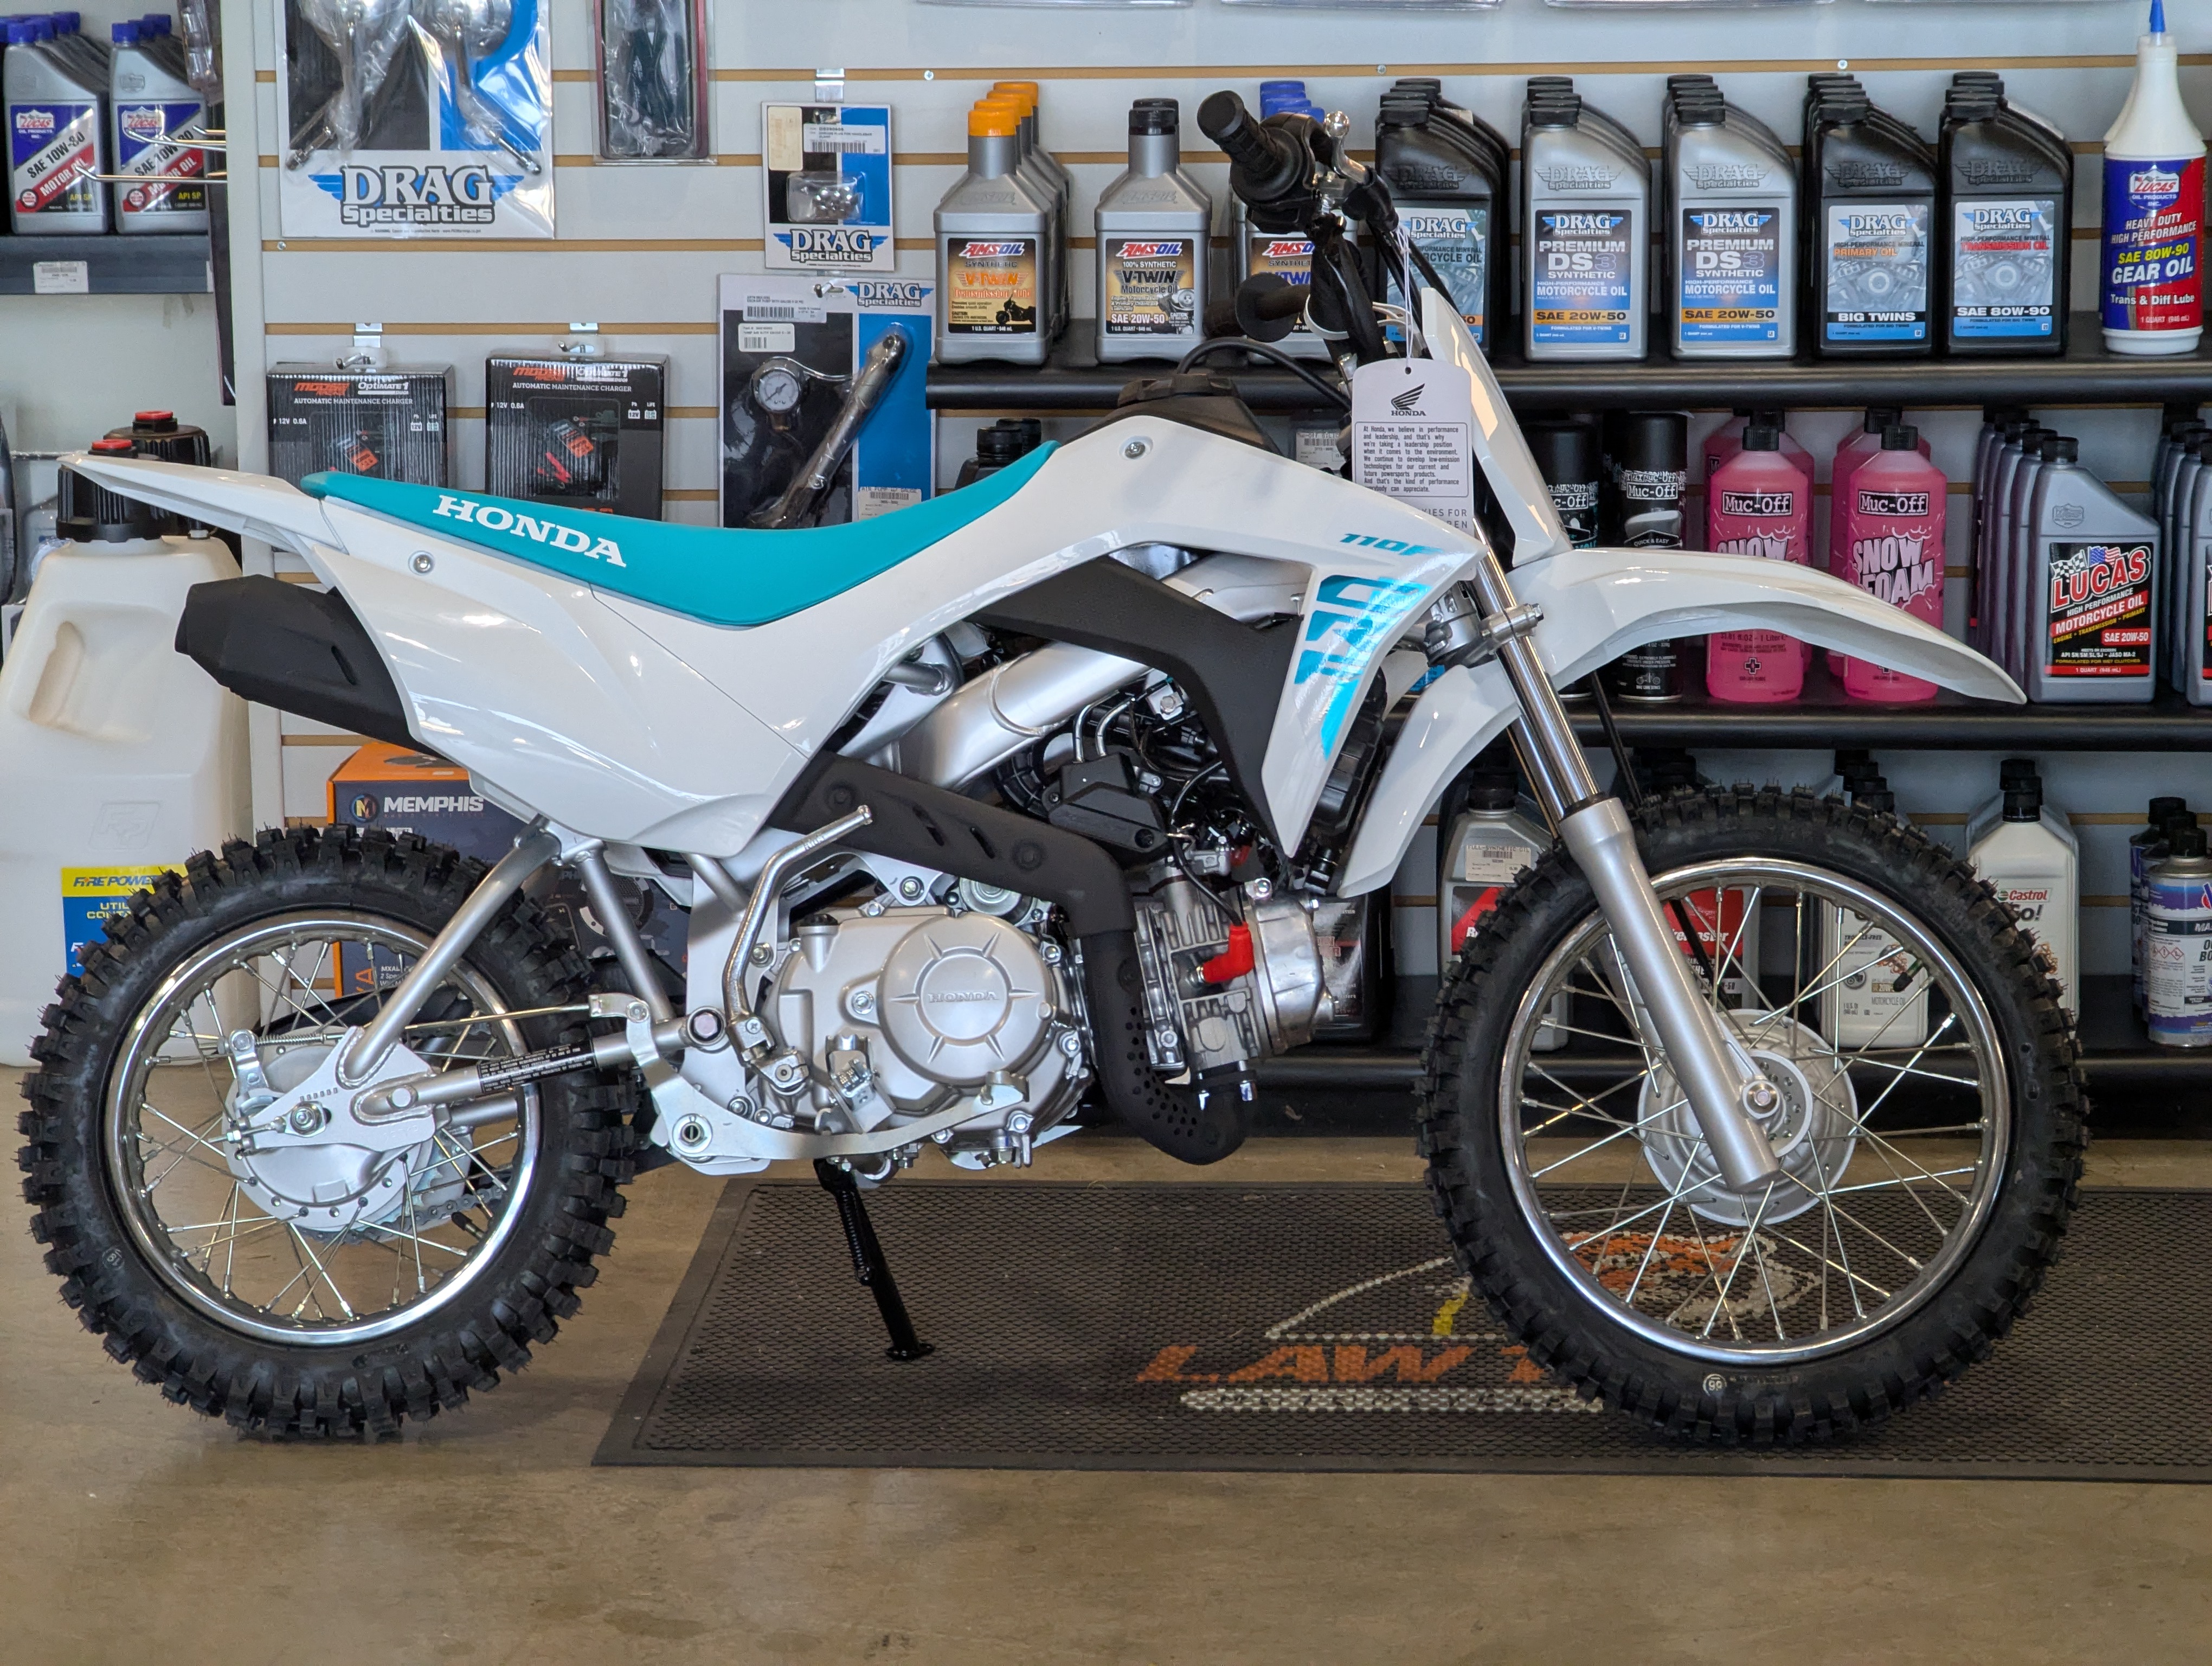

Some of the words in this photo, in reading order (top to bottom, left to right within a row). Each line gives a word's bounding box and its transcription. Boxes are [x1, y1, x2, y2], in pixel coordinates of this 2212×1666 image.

[27, 159, 48, 178] SAE
[134, 158, 155, 176] SAE
[179, 157, 197, 172] OIL
[40, 169, 73, 196] MOTOR
[340, 165, 494, 205] DRAG
[2134, 182, 2176, 193] LUCAS
[342, 205, 494, 226] Specialties
[1554, 213, 1611, 230] DRAG
[1702, 212, 1759, 228] DRAG
[1849, 215, 1907, 231] DRAG
[1974, 208, 2031, 225] DRAG
[2125, 217, 2155, 230] HEAVY
[2158, 212, 2182, 226] DUTY
[1410, 217, 1466, 233] DRAG
[1702, 226, 1760, 234] Specialties
[2111, 233, 2129, 244] HIGH
[2132, 220, 2196, 242] PERFORMANCE
[790, 229, 872, 252] DRAG
[1410, 231, 1466, 239] Specialties
[959, 242, 1025, 259] AMSOIL
[1116, 242, 1182, 259] AMSOIL
[1262, 241, 1315, 258] AMSO
[1539, 241, 1625, 252] PREMIUM
[1687, 239, 1773, 251] PREMIUM
[1834, 248, 1877, 257] PRIMARY
[1881, 248, 1898, 257] OIL
[2034, 241, 2049, 250] OIL
[790, 251, 872, 262] Specialties
[1465, 253, 1482, 263] OIL
[1696, 251, 1764, 270] DS3
[2118, 251, 2142, 264] SAE
[2145, 243, 2189, 260] 80W-90
[1548, 253, 1616, 271] DS3
[1122, 271, 1176, 283] V-TWIN
[2112, 262, 2161, 285] GEAR
[2165, 256, 2194, 277] OIL
[858, 282, 921, 299] DRAG
[954, 288, 1009, 298] Transmission
[1121, 285, 1166, 294] Motorcycle
[1168, 285, 1177, 293] Oil
[1537, 286, 1609, 296] MOTORCYCLE
[1611, 286, 1627, 296] OIL
[1685, 285, 1756, 294] MOTORCYCLE
[1759, 285, 1776, 294] OIL
[858, 298, 921, 307] Specialties
[2111, 294, 2136, 305] Trans
[2139, 295, 2147, 305] &
[2151, 294, 2170, 305] Diff
[2174, 294, 2195, 305] Lube
[1111, 313, 1128, 323] SAE
[1130, 313, 1165, 324] 20W-50
[1536, 312, 1565, 321] SAE
[1569, 312, 1626, 321] 20W-50
[1685, 310, 1713, 319] SAE
[1717, 310, 1774, 319] 20W-50
[1838, 312, 1865, 322] BIG
[1869, 312, 1916, 322] TWINS
[1957, 307, 1987, 316] SAE
[1990, 306, 2050, 316] 80W-90
[2146, 316, 2165, 324] QUART
[1628, 485, 1676, 498] Muc-Off
[1553, 496, 1587, 507] c-Off
[1725, 495, 1789, 514] Muc-Off
[1861, 495, 1926, 513] Muc-Off
[433, 495, 627, 567] HONDA
[1340, 533, 1444, 556] 110F
[1853, 536, 1925, 575] SNOW
[1862, 558, 1935, 604] FOAM
[2052, 548, 2149, 611] LUCAS
[2067, 606, 2082, 617] HIGH
[2085, 588, 2133, 611] PERFORMANCE
[2056, 601, 2125, 633] MOTORCYCLE
[2127, 595, 2144, 609] OIL
[2054, 634, 2072, 644] ENGINE
[2079, 618, 2117, 635] TRANSMISSION
[2123, 607, 2145, 620] PRIMARY
[2104, 632, 2119, 642] SAE
[2121, 632, 2149, 642] 20W-50
[384, 796, 484, 812] MEMPHIS
[73, 876, 107, 887] FIRE
[2009, 890, 2048, 900] Castrol
[100, 902, 130, 911] UTIL
[928, 991, 1000, 1003] HONDA
[1135, 1344, 1479, 1383] LAW
